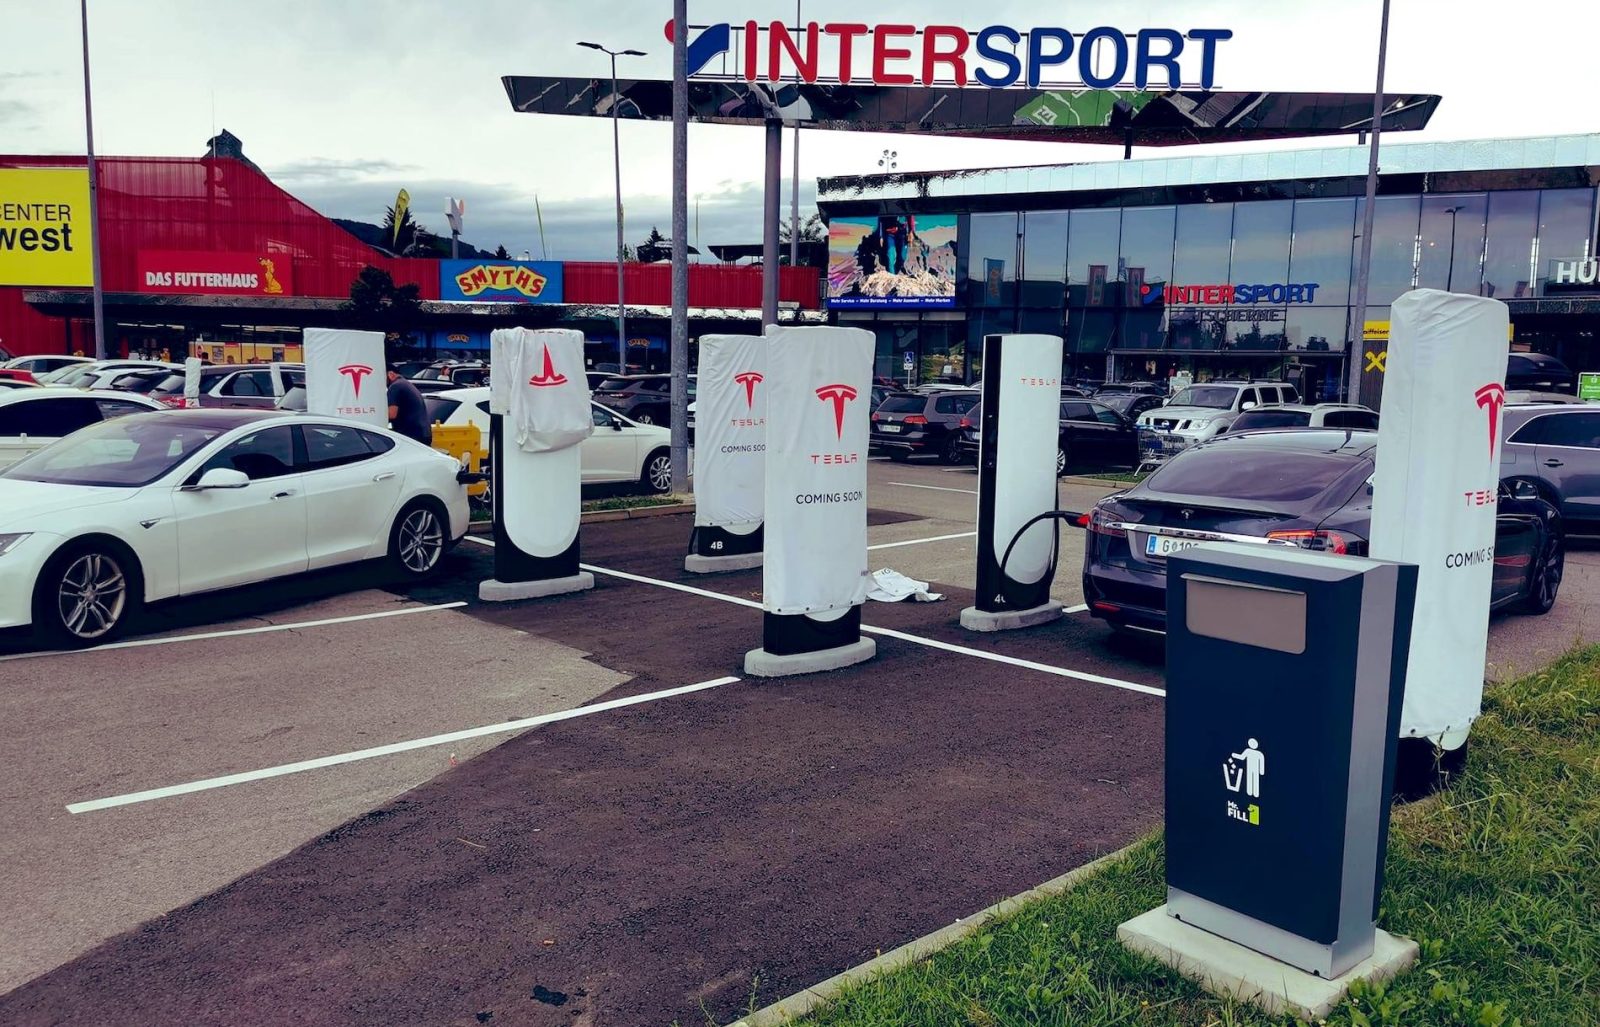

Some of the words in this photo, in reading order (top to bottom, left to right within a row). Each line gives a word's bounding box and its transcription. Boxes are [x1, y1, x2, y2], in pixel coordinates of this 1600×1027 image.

[744, 19, 1233, 91] INTERSPORT
[0, 203, 72, 221] ENTER
[145, 271, 172, 286] DAS
[174, 272, 259, 288] FUTTERHAUS
[459, 268, 544, 294] SMYTHS
[1164, 284, 1320, 305] INTERSPORT
[1021, 378, 1056, 386] TESLA
[336, 407, 376, 415] TESLA
[731, 418, 764, 426] TESLA
[720, 445, 752, 453] COMING
[753, 444, 766, 452] SOO
[811, 453, 857, 464] TESLA
[796, 493, 840, 504] COMING
[710, 541, 723, 550] 4B
[1162, 540, 1170, 552] G
[1445, 549, 1485, 568] COMING
